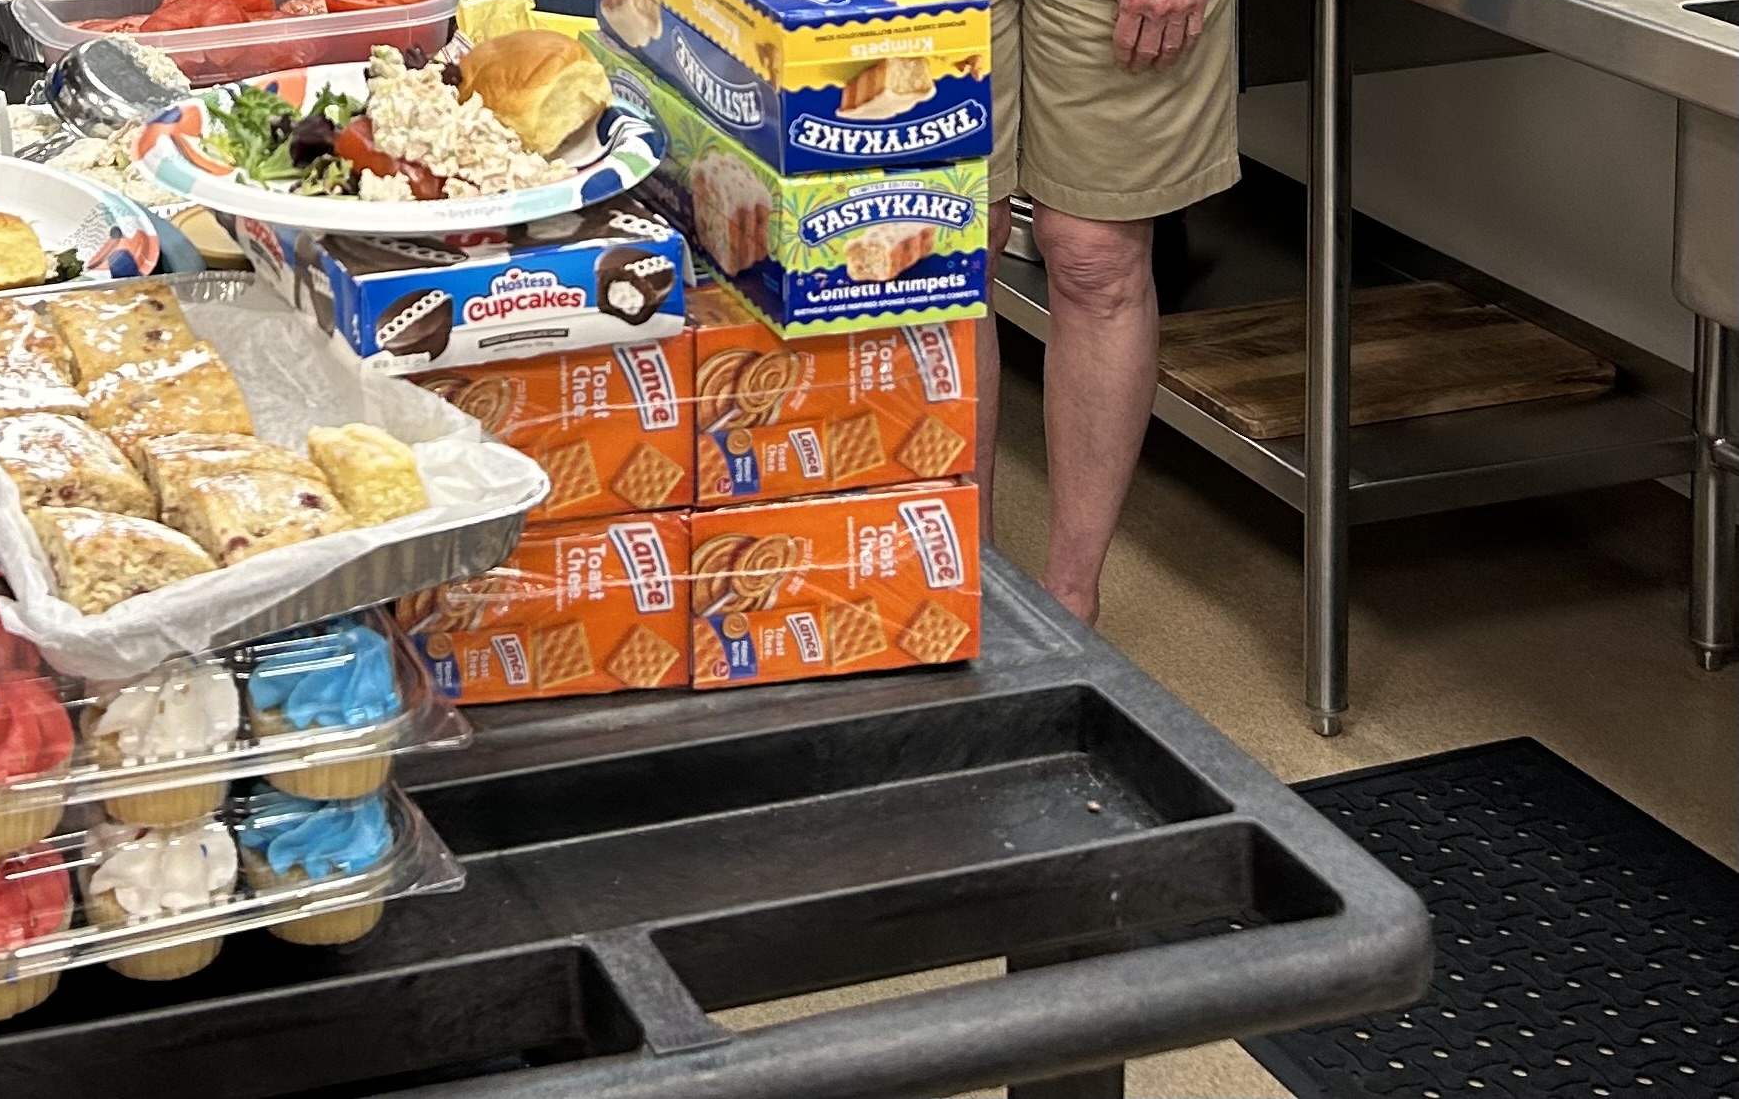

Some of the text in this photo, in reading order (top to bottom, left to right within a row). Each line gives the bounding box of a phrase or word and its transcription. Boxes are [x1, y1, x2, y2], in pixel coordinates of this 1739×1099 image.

[849, 35, 935, 58] Krimpets
[675, 35, 762, 124] TASTYKAKE
[797, 107, 980, 155] TASTYKAKE
[807, 193, 968, 239] TASTYKAKE
[467, 290, 582, 322] Cupcakes
[496, 275, 554, 294] Hostess
[884, 273, 967, 294] Krimpets
[630, 345, 671, 425] Lance
[877, 335, 897, 392] Toast
[591, 361, 612, 419] Toast
[798, 430, 821, 474] Lance
[624, 527, 666, 605] Lance
[878, 521, 898, 578] Toast
[915, 504, 957, 581] Lance
[587, 543, 607, 600] Toast
[500, 637, 526, 682] Lance
[795, 615, 820, 659] Lance
